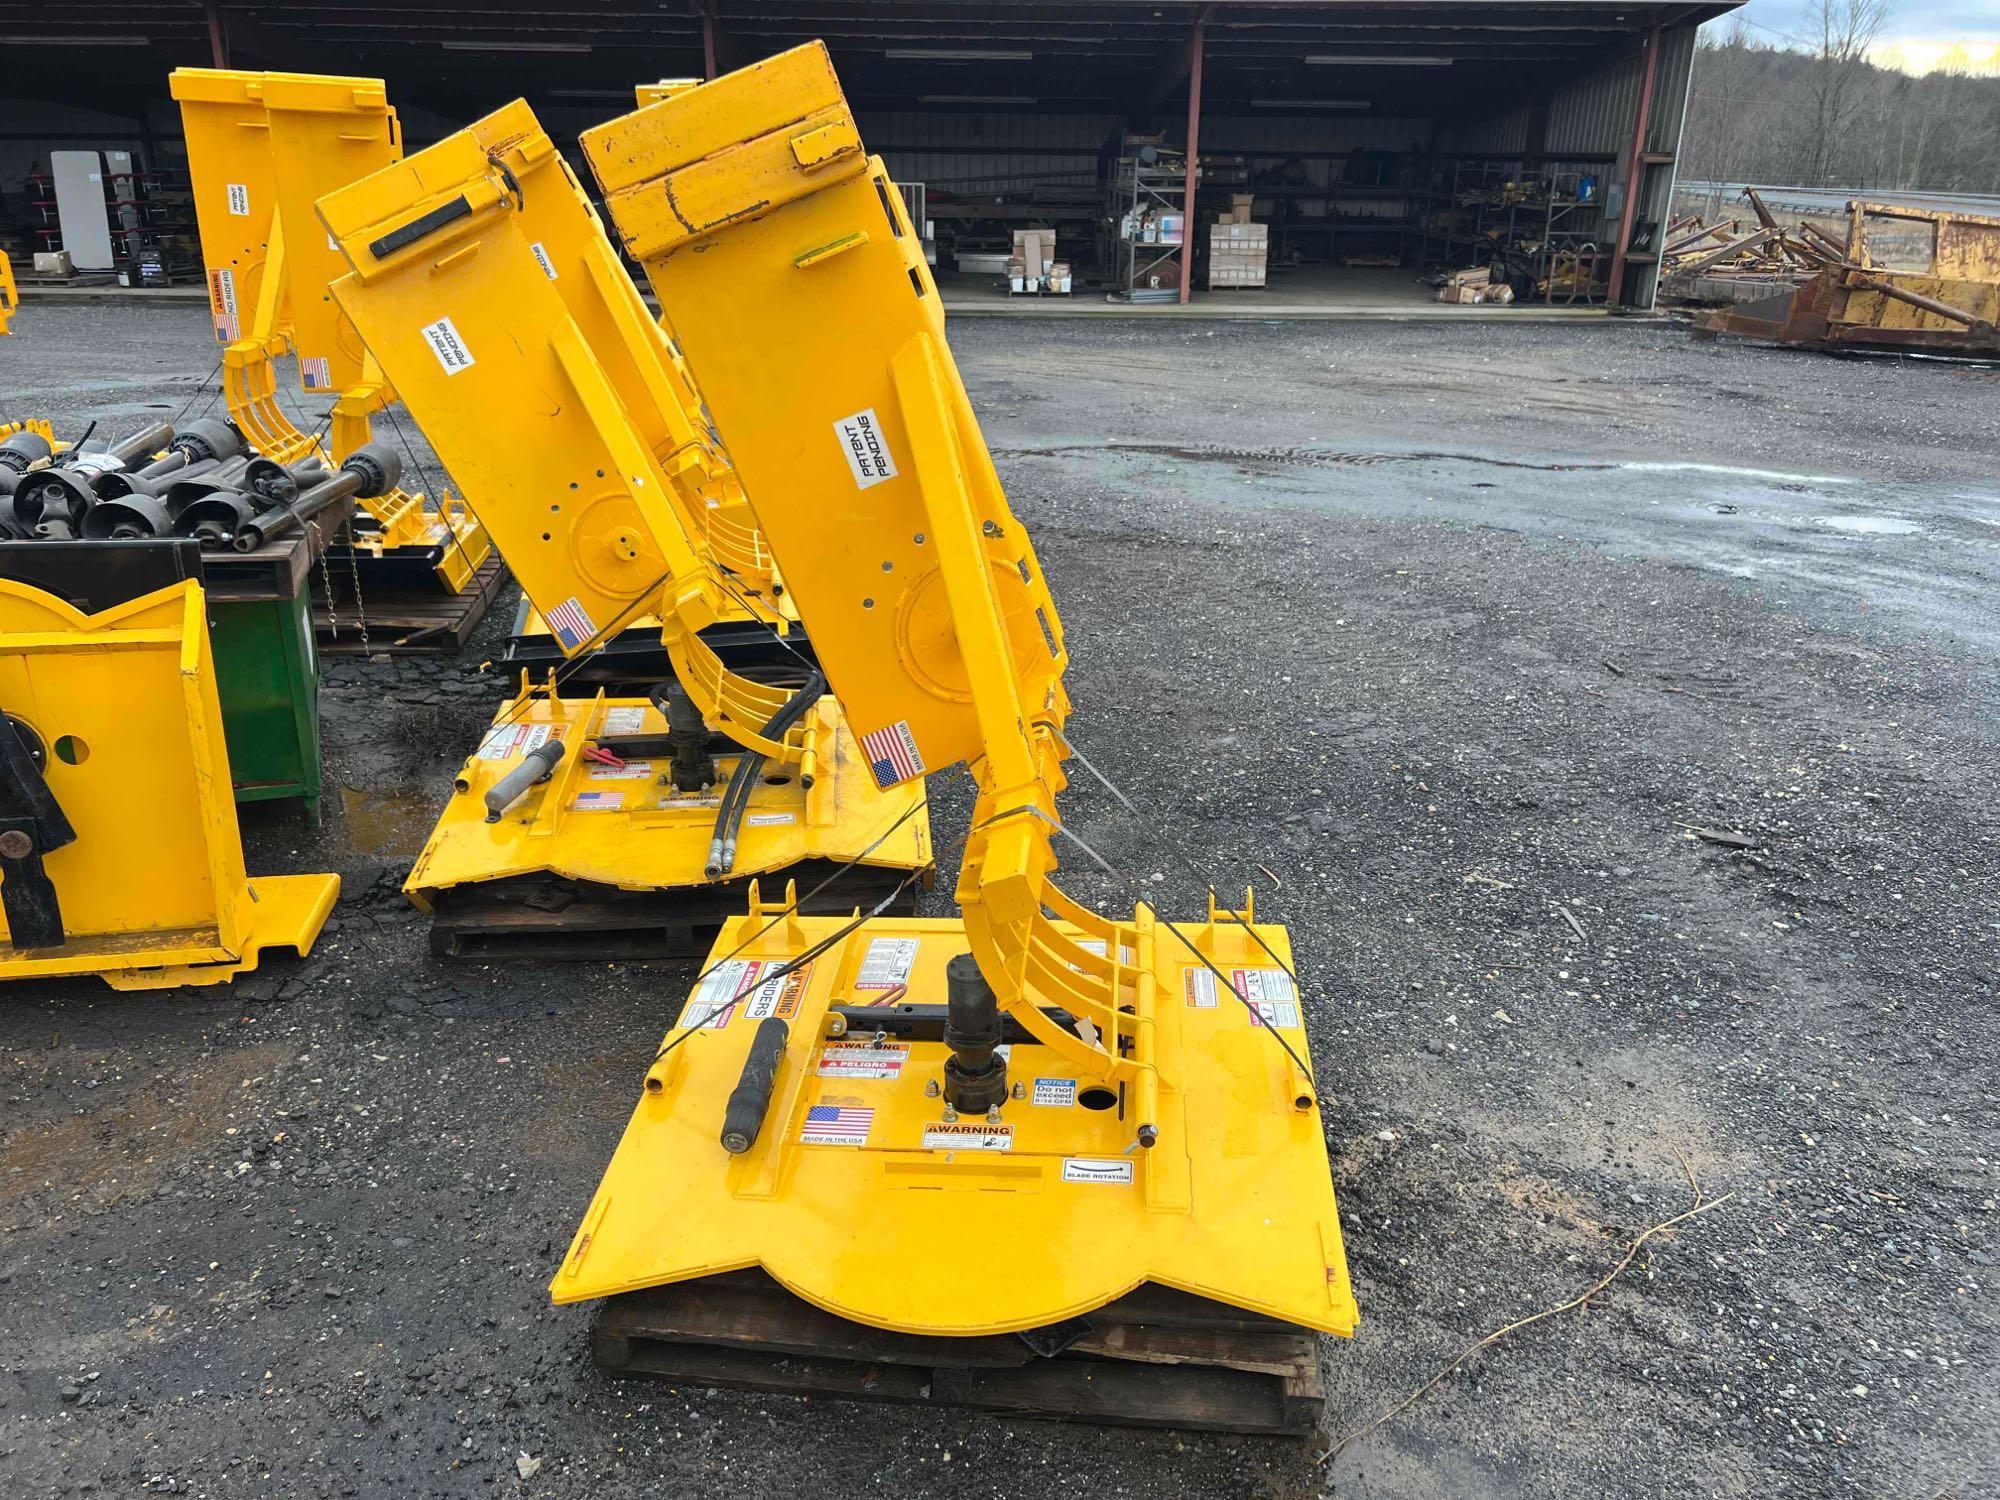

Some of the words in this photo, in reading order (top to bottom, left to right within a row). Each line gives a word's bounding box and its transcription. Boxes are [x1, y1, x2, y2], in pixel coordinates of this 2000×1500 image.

[212, 273, 221, 303] WARNING
[222, 272, 232, 300] RIDERS
[227, 302, 234, 312] NO
[428, 330, 457, 366] PATENT
[437, 322, 468, 365] PENDING
[844, 425, 875, 477] PATENT
[857, 416, 890, 477] PENDING
[754, 980, 778, 1016] RIDERS
[778, 976, 803, 1014] WARNING
[938, 1126, 1010, 1134] WARNING
